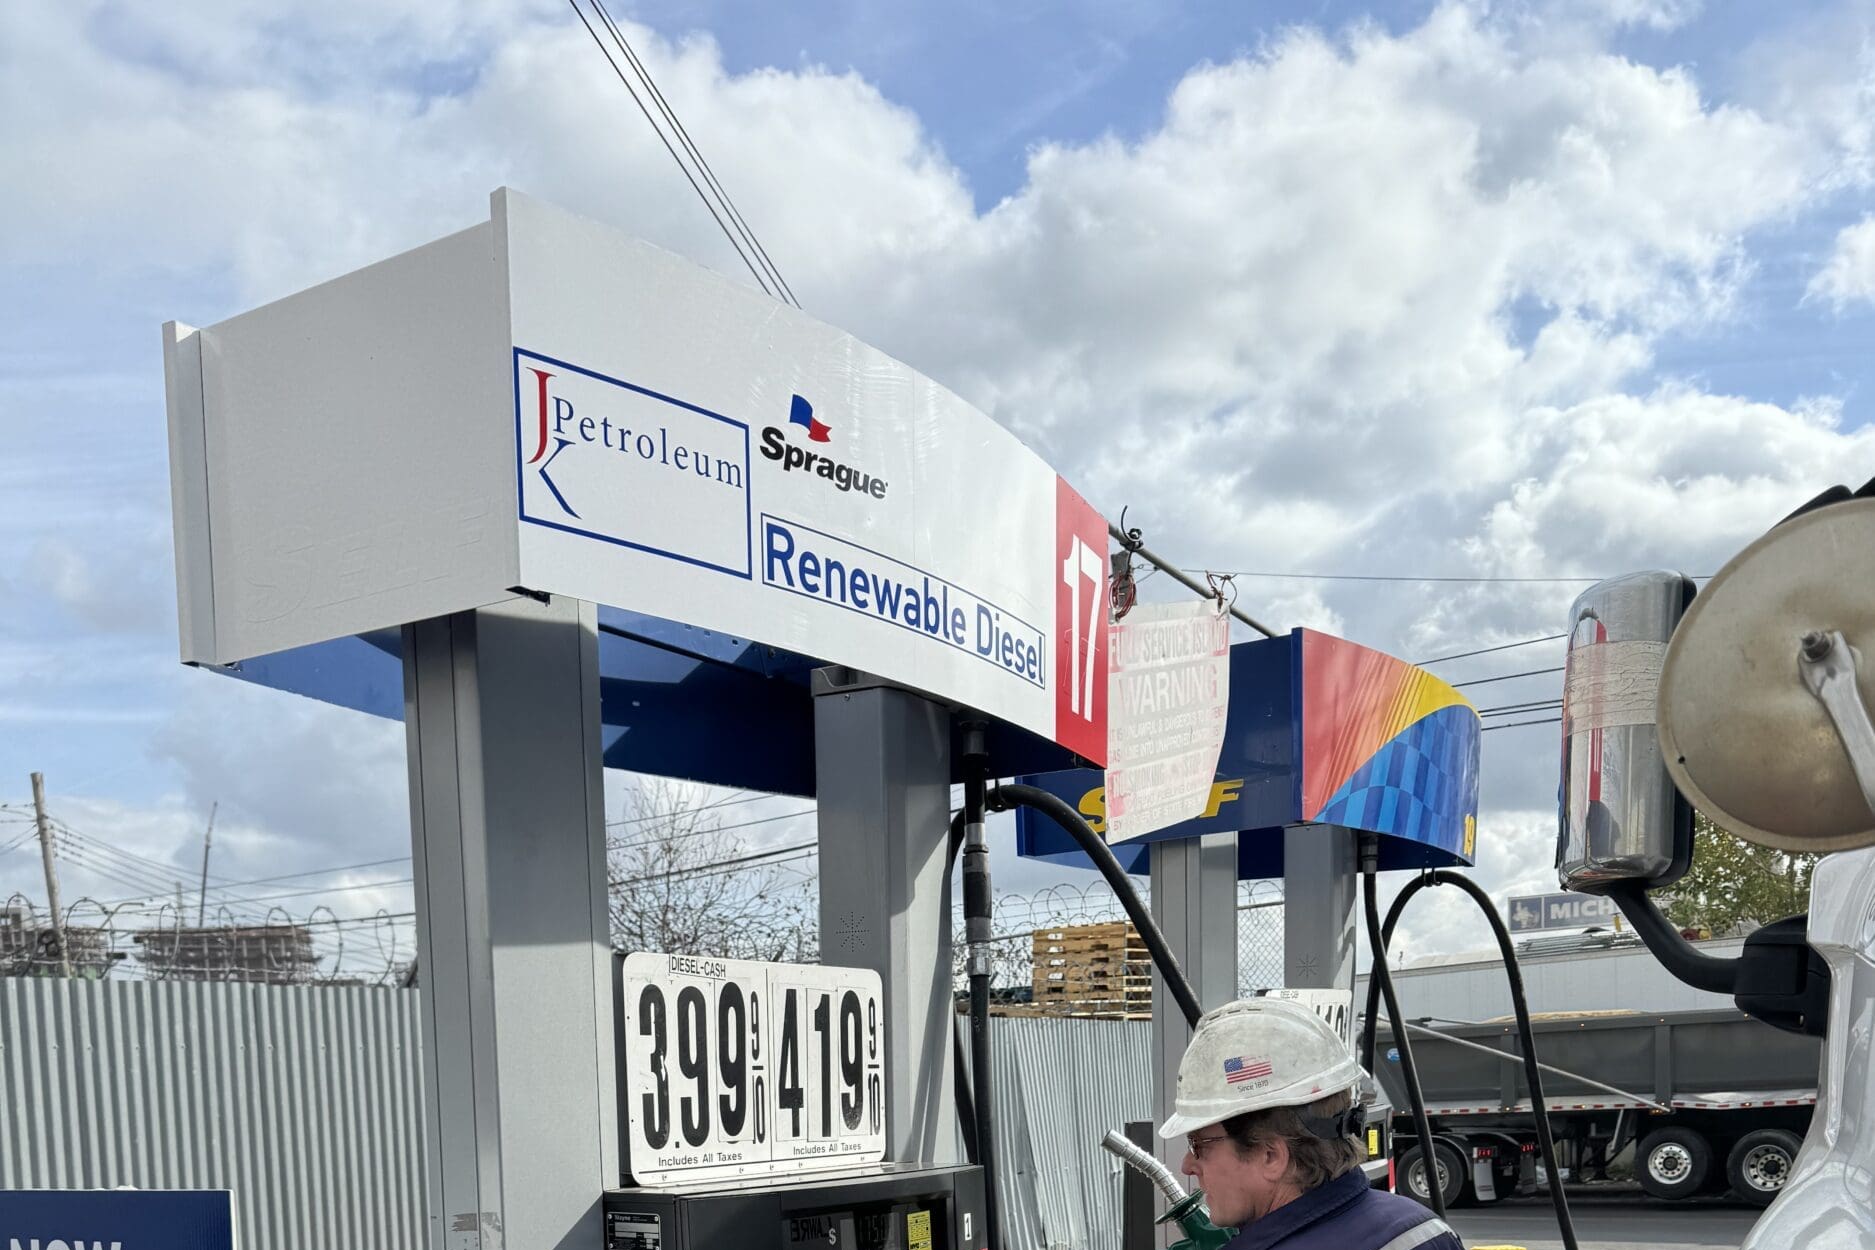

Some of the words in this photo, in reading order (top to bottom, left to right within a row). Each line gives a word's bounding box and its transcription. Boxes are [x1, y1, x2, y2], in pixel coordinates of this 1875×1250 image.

[553, 394, 744, 490] Petroleum
[759, 425, 888, 501] Sprague
[765, 522, 967, 647] Renewable
[976, 602, 1045, 687] Diesel
[1063, 534, 1104, 724] 17
[1144, 624, 1190, 663] SERVICE
[1118, 662, 1217, 717] WARNING
[671, 956, 726, 978] DIESEL-CASH
[1237, 1083, 1254, 1093] Since
[658, 1155, 698, 1167] Includes
[702, 1152, 714, 1163] All
[717, 1151, 743, 1162] Taxes
[793, 1144, 826, 1156] Includes
[828, 1142, 838, 1153] All
[841, 1141, 862, 1152] Taxes
[828, 1228, 837, 1246] $
